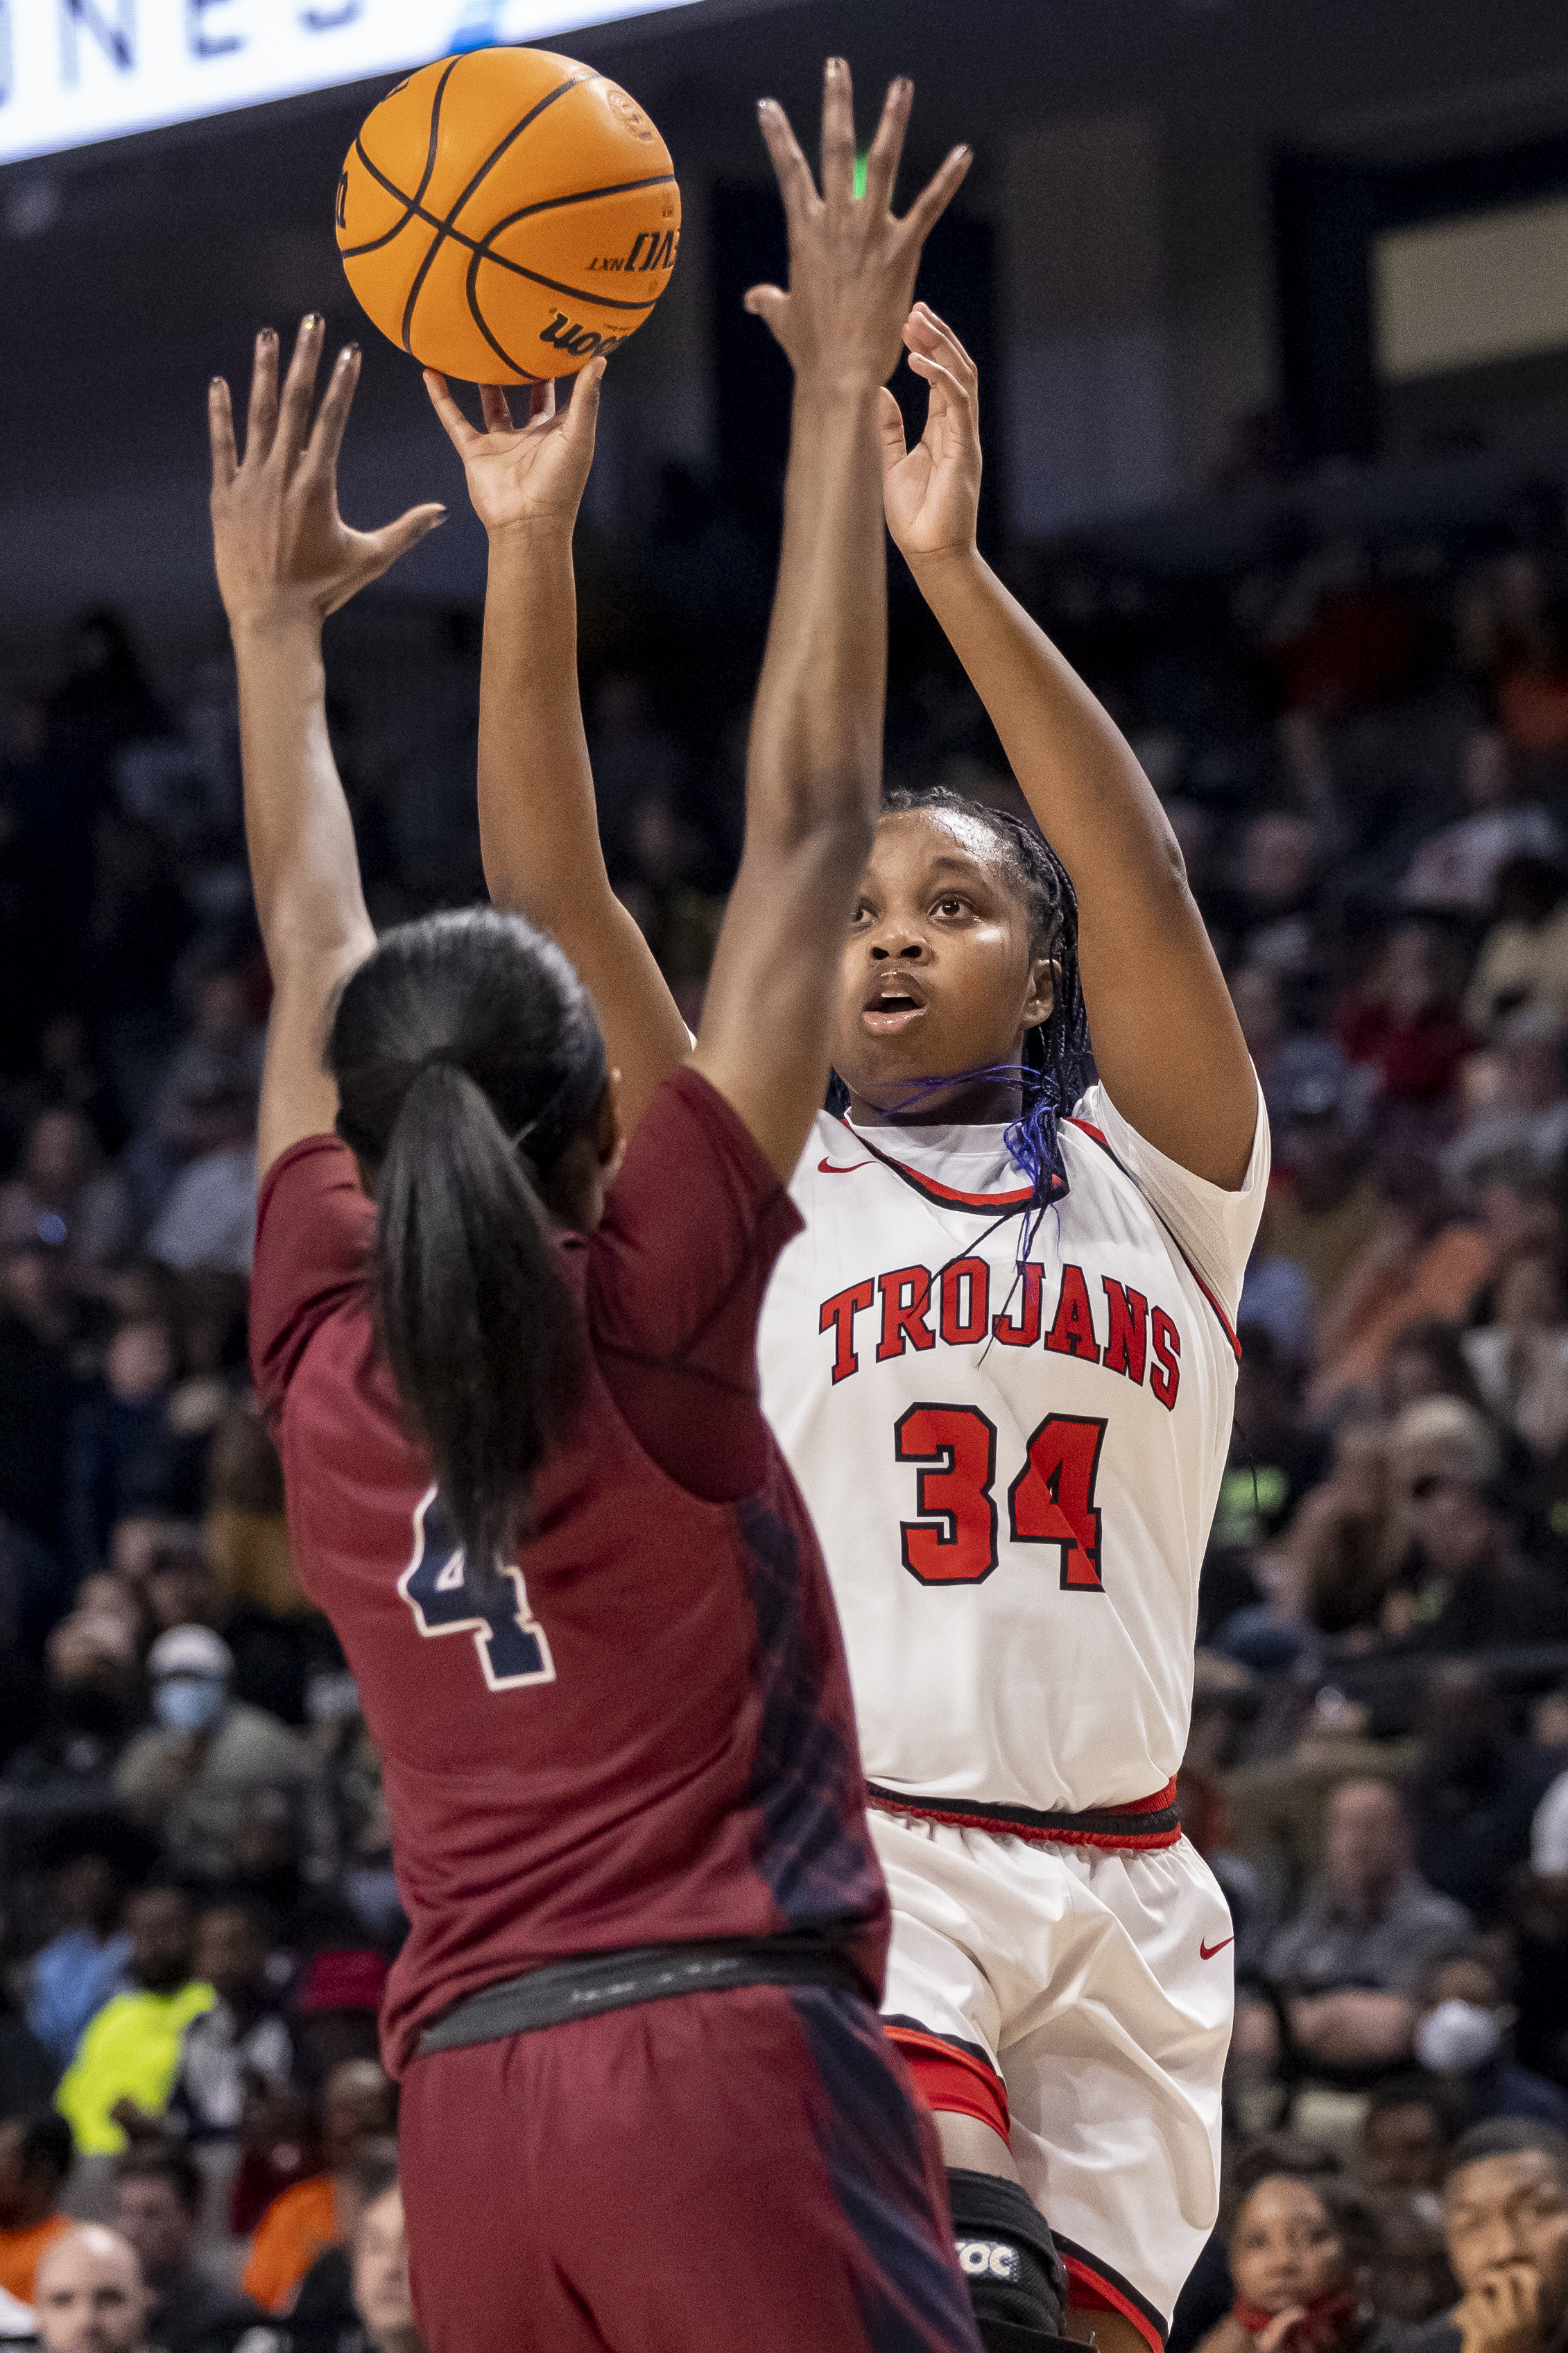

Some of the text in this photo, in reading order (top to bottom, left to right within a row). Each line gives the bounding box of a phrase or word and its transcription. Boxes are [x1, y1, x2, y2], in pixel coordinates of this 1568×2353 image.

[584, 257, 625, 271] NXT
[819, 1256, 1181, 1412] TROJANS
[894, 1401, 1109, 1593] 34
[397, 1478, 557, 1693] 4
[954, 2241, 1013, 2277] OC
